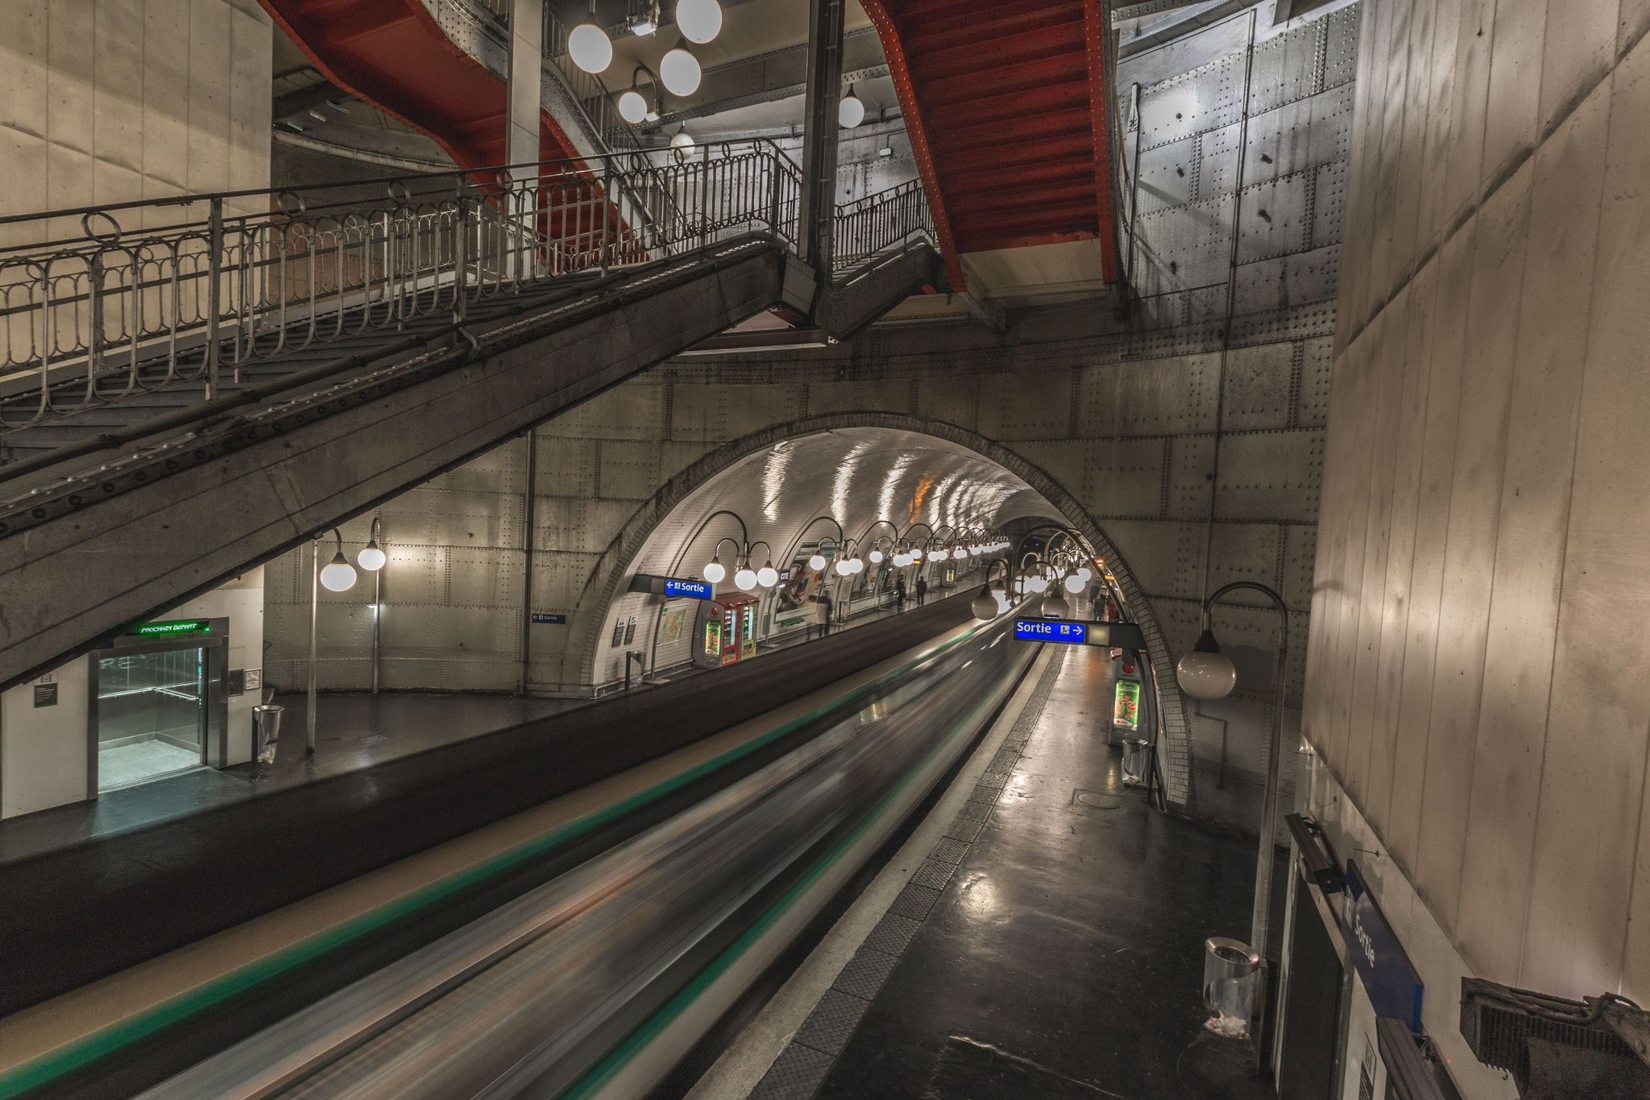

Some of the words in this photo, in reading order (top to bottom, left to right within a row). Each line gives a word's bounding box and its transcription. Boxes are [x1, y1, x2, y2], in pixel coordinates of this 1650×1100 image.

[681, 582, 704, 592] Sortie
[1017, 621, 1052, 634] Sortie
[1355, 914, 1375, 968] Sortie
